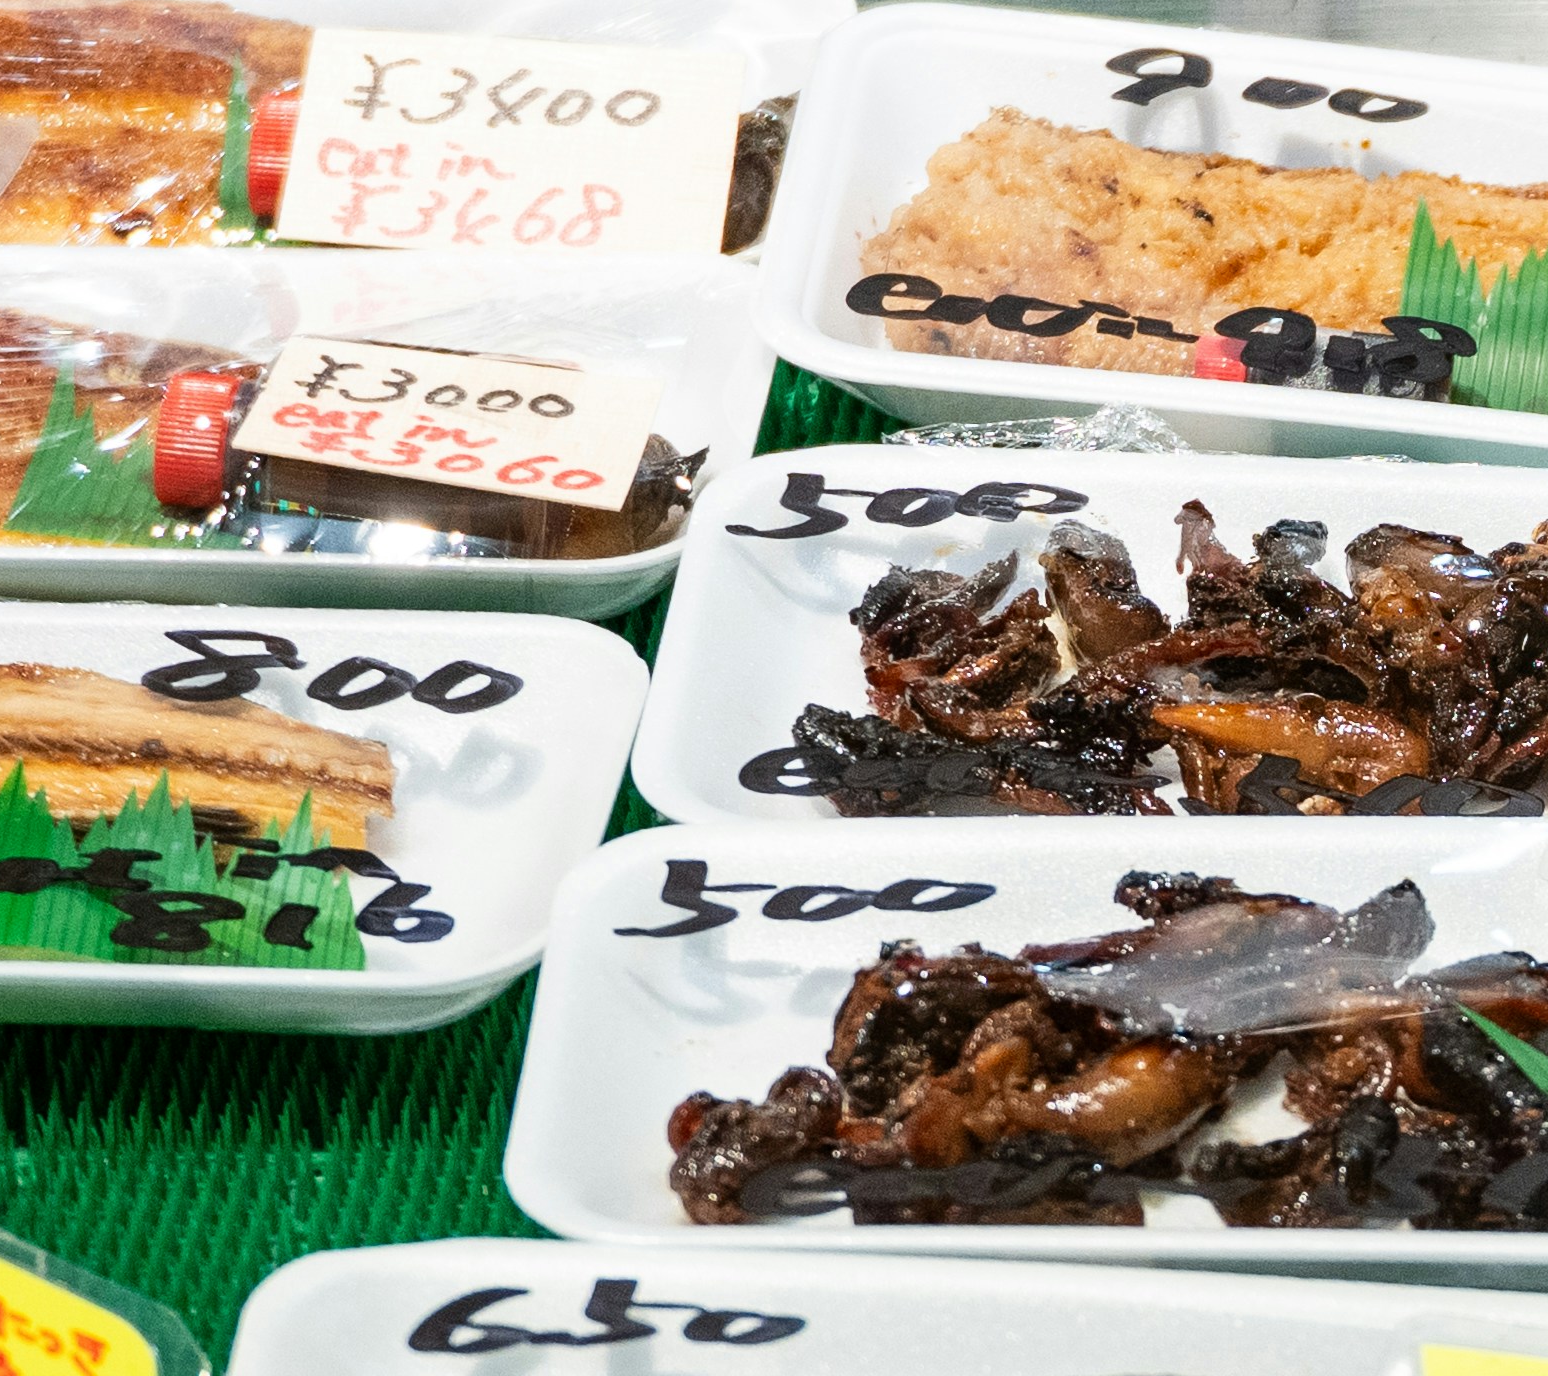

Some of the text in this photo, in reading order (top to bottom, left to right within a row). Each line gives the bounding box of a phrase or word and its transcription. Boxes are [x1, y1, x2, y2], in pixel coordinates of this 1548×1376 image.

[1105, 47, 1430, 124] 900
[438, 142, 515, 181] in
[295, 354, 575, 419] ¥3000
[272, 402, 497, 449] eat in
[300, 431, 605, 491] ¥3060
[724, 472, 1088, 539] 500
[142, 630, 524, 714] 800
[613, 860, 995, 938] 500
[406, 1277, 805, 1355] 650
